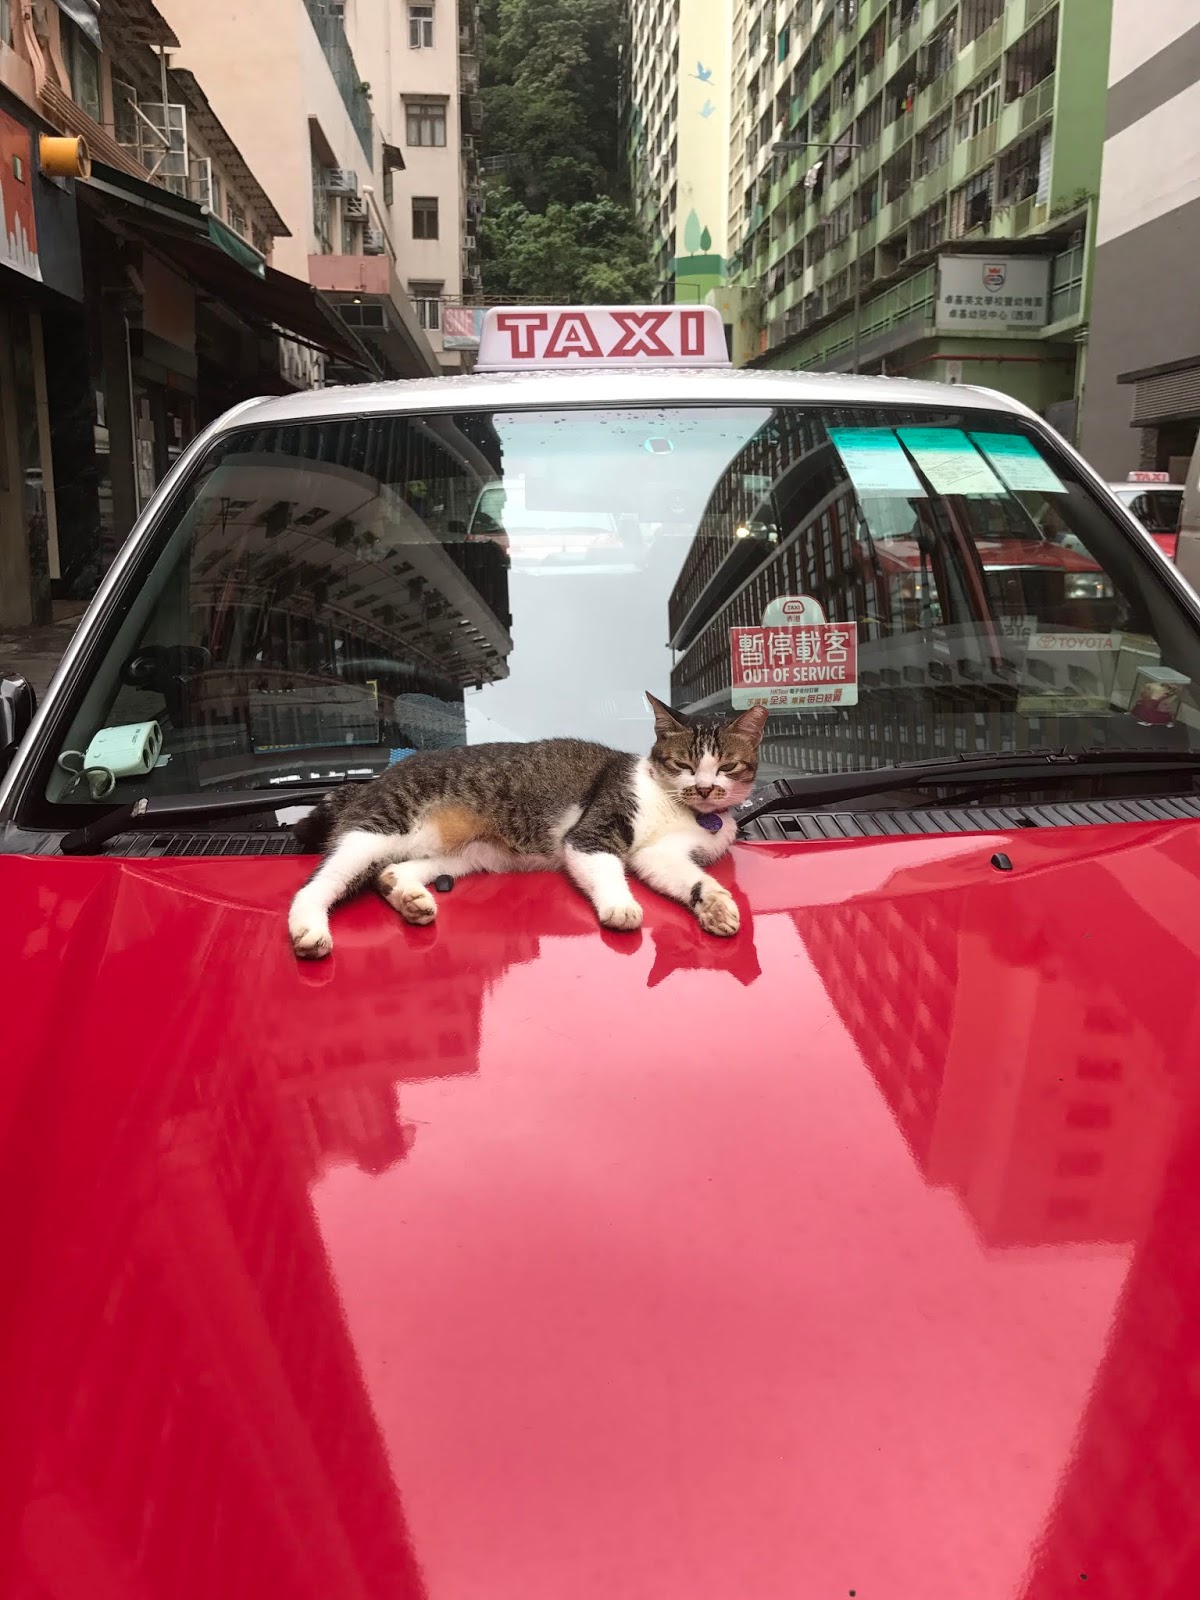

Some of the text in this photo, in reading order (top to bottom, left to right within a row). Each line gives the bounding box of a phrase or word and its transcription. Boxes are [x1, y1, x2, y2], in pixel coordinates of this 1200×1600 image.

[497, 311, 705, 359] TAXI
[1134, 472, 1166, 481] TAXI
[786, 615, 801, 623] 香港
[738, 629, 849, 666] 暫停載客
[1059, 636, 1113, 648] TOYOTA
[743, 665, 845, 684] OUT OF SERVICE
